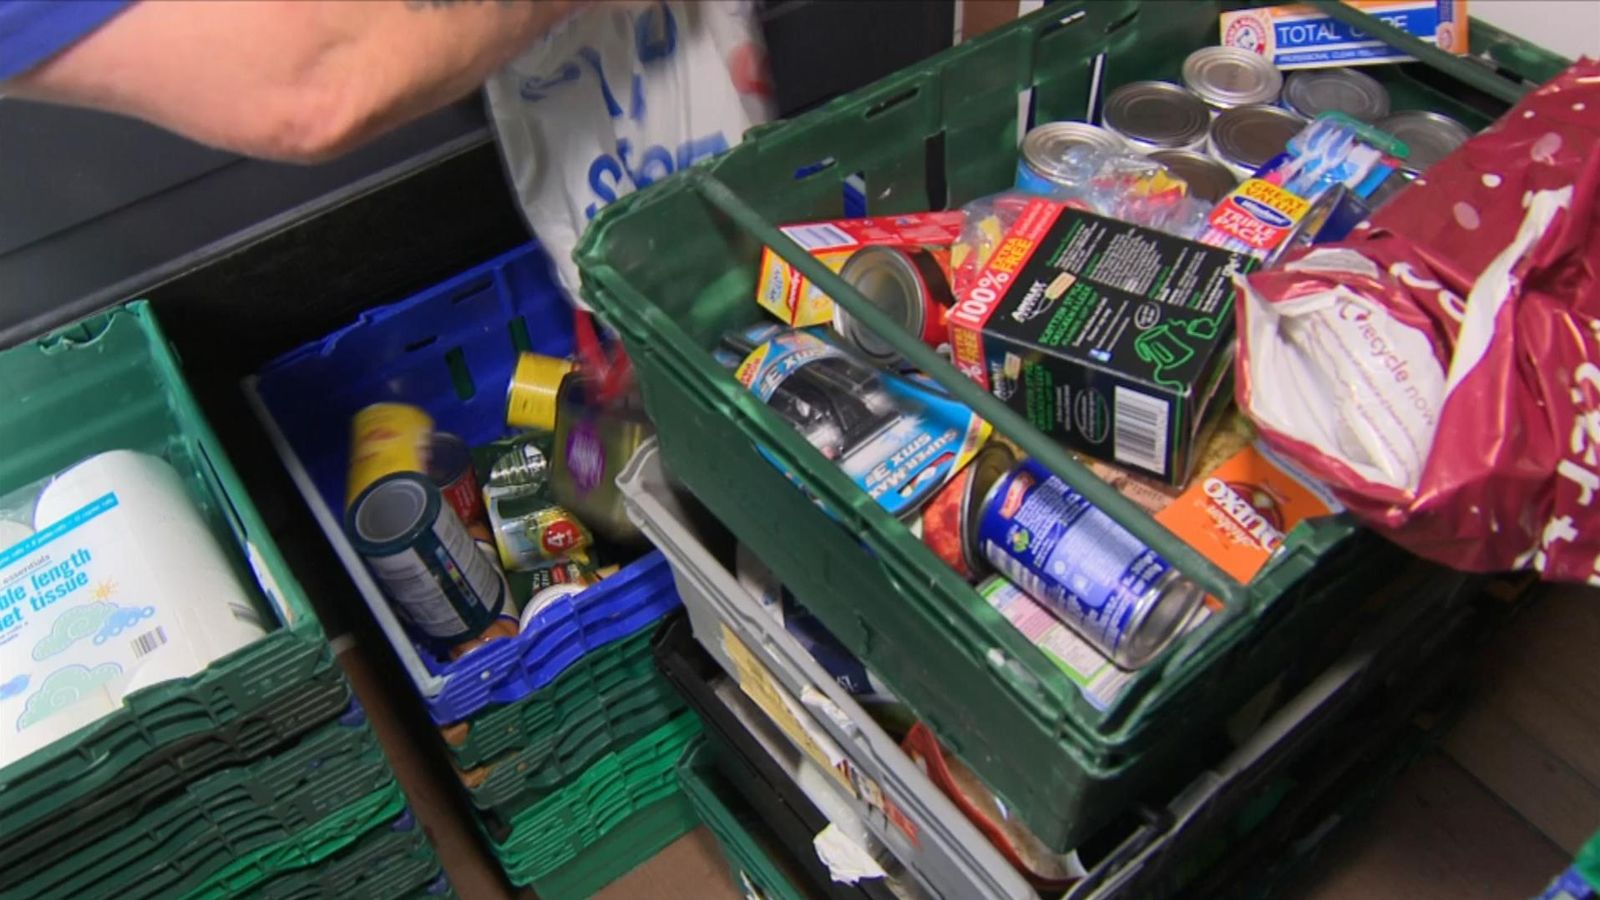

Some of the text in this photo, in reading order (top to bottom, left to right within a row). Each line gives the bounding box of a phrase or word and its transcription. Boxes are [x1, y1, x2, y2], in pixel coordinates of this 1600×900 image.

[1278, 22, 1342, 44] TOTAL
[1215, 214, 1269, 247] PACK
[1221, 208, 1278, 239] TRIPLE
[1001, 238, 1034, 274] FREE
[955, 270, 1010, 324] 100%
[1357, 317, 1435, 426] recycle now
[31, 548, 92, 589] length
[0, 571, 90, 632] et tissue
